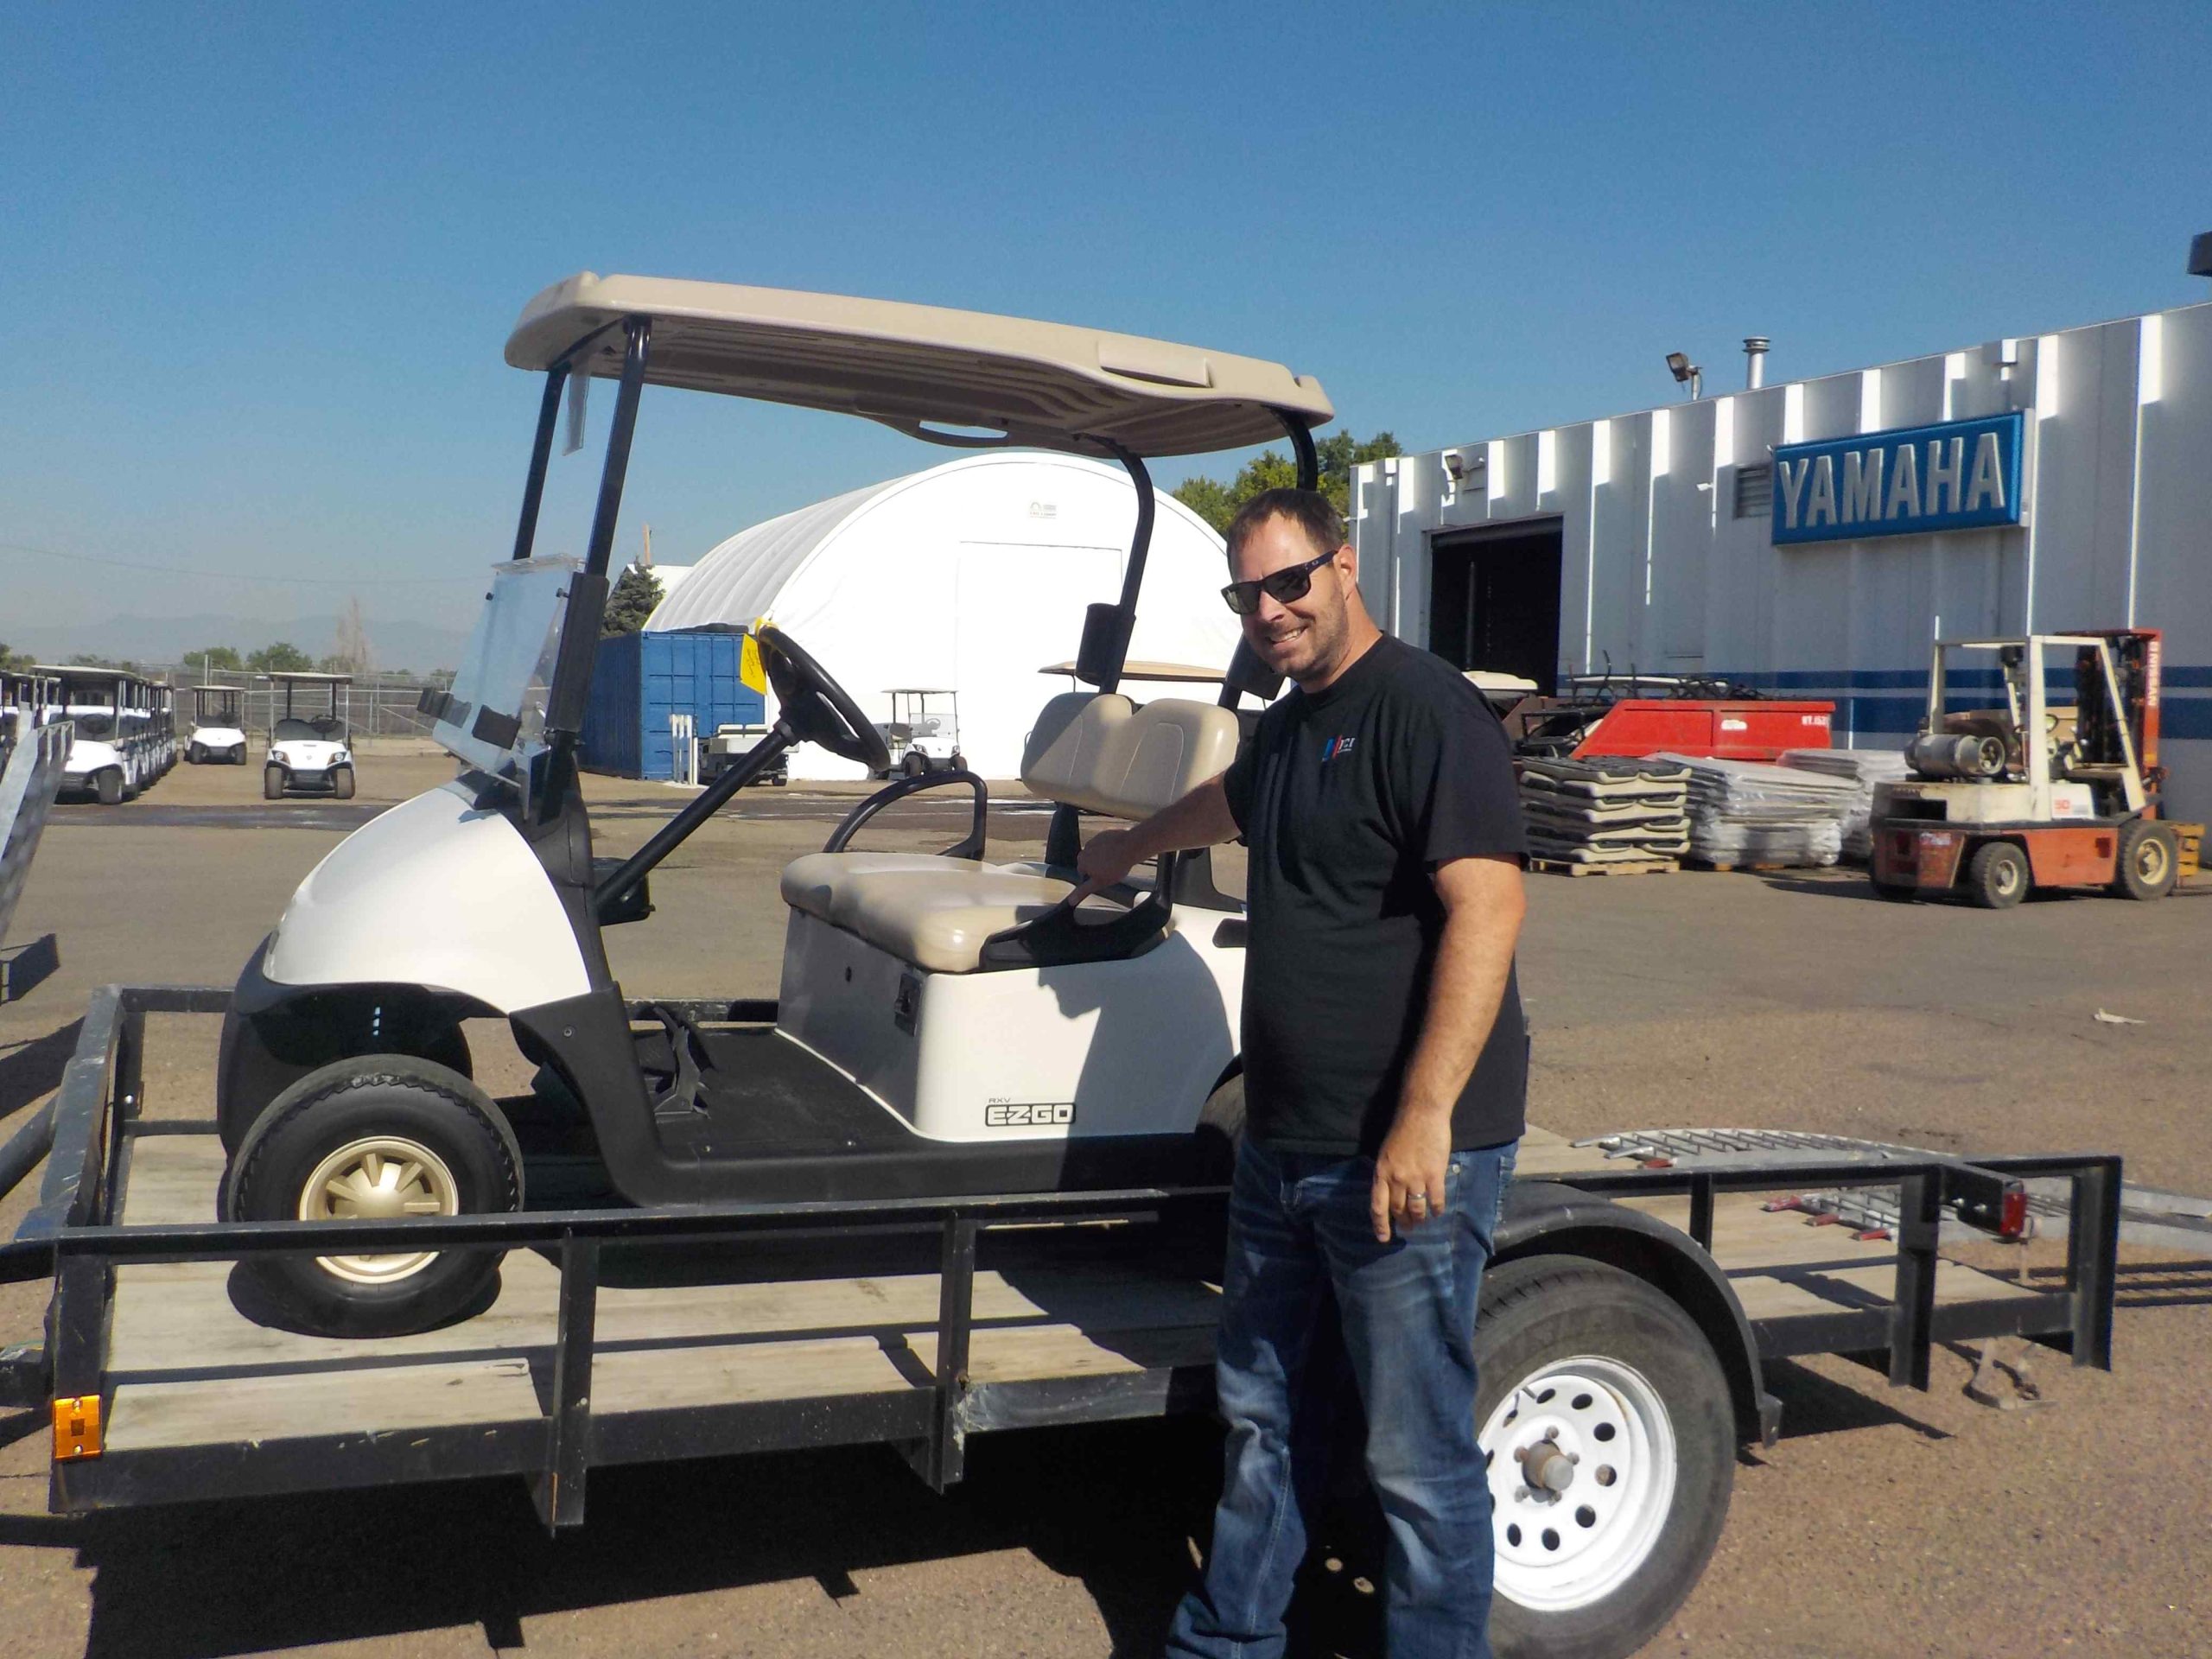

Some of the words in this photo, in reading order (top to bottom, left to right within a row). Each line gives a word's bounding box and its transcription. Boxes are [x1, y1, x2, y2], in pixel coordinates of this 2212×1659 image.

[1778, 431, 2005, 529] YAMAHA
[2146, 652, 2159, 706] NISSAN
[985, 1103, 1076, 1127] EZGO
